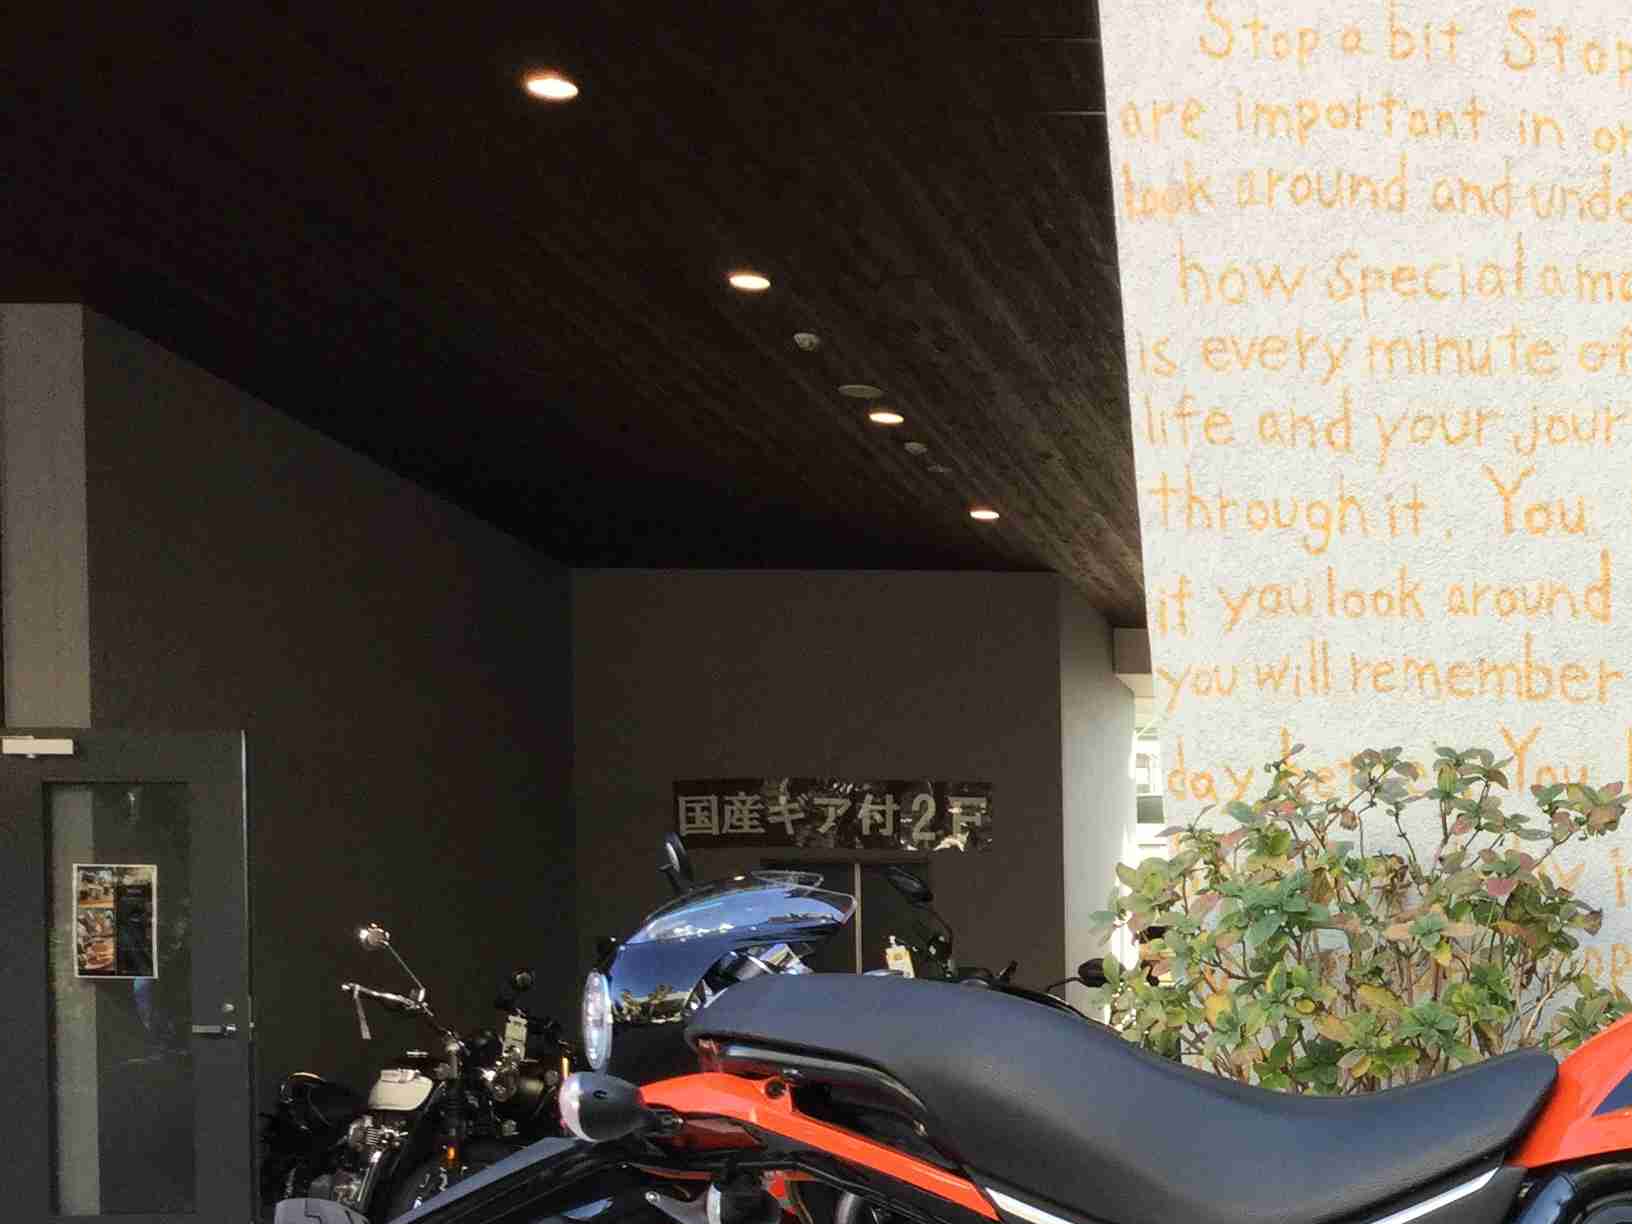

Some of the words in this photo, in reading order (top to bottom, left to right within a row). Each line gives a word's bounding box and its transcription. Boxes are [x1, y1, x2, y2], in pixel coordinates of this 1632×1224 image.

[1198, 0, 1320, 72] Stop
[1385, 0, 1464, 64] bit
[1118, 96, 1208, 142] are
[1234, 90, 1488, 146] important
[1518, 110, 1565, 145] in
[1233, 153, 1410, 213] around
[1428, 158, 1514, 219] and
[1176, 238, 1306, 304] how
[1540, 257, 1574, 300] a
[1139, 333, 1178, 378] is
[1200, 325, 1350, 384] every
[1364, 323, 1556, 380] minute
[1143, 390, 1235, 450] life
[1256, 385, 1352, 454] and
[1374, 408, 1505, 470] your
[1148, 468, 1372, 556] through
[1482, 464, 1588, 538] You
[1218, 583, 1316, 633] you
[1326, 562, 1426, 622] look
[1444, 547, 1612, 624] around
[1155, 662, 1238, 712] you
[1254, 640, 1332, 700] will
[1347, 630, 1624, 704] remember
[1166, 735, 1255, 801] day
